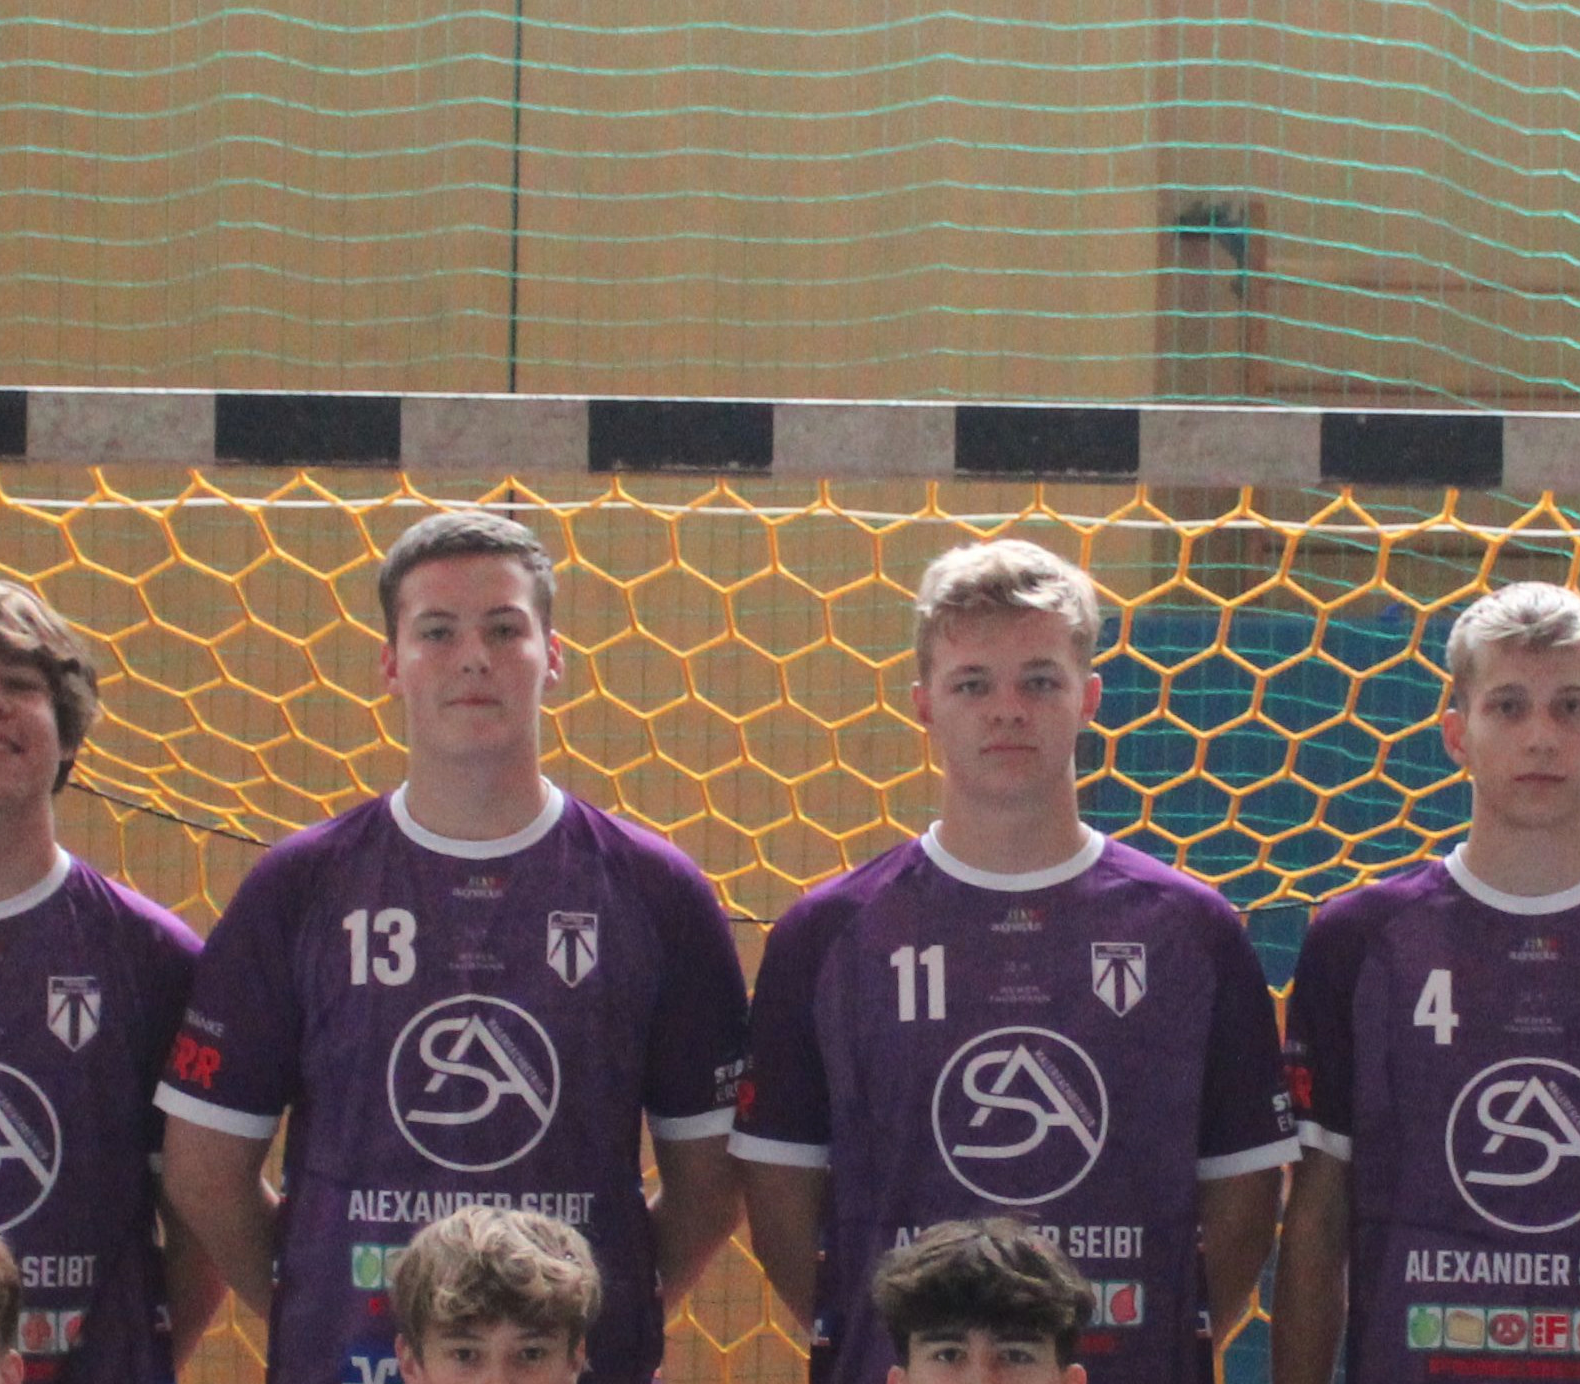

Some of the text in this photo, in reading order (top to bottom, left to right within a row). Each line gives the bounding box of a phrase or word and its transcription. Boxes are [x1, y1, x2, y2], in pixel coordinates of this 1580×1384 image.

[342, 908, 418, 986] 13
[890, 944, 946, 1022] 11
[1413, 969, 1459, 1045] 4
[1069, 1226, 1144, 1259] SEIBT
[1405, 1249, 1570, 1286] ALEXANDER
[22, 1255, 97, 1288] SEIBT
